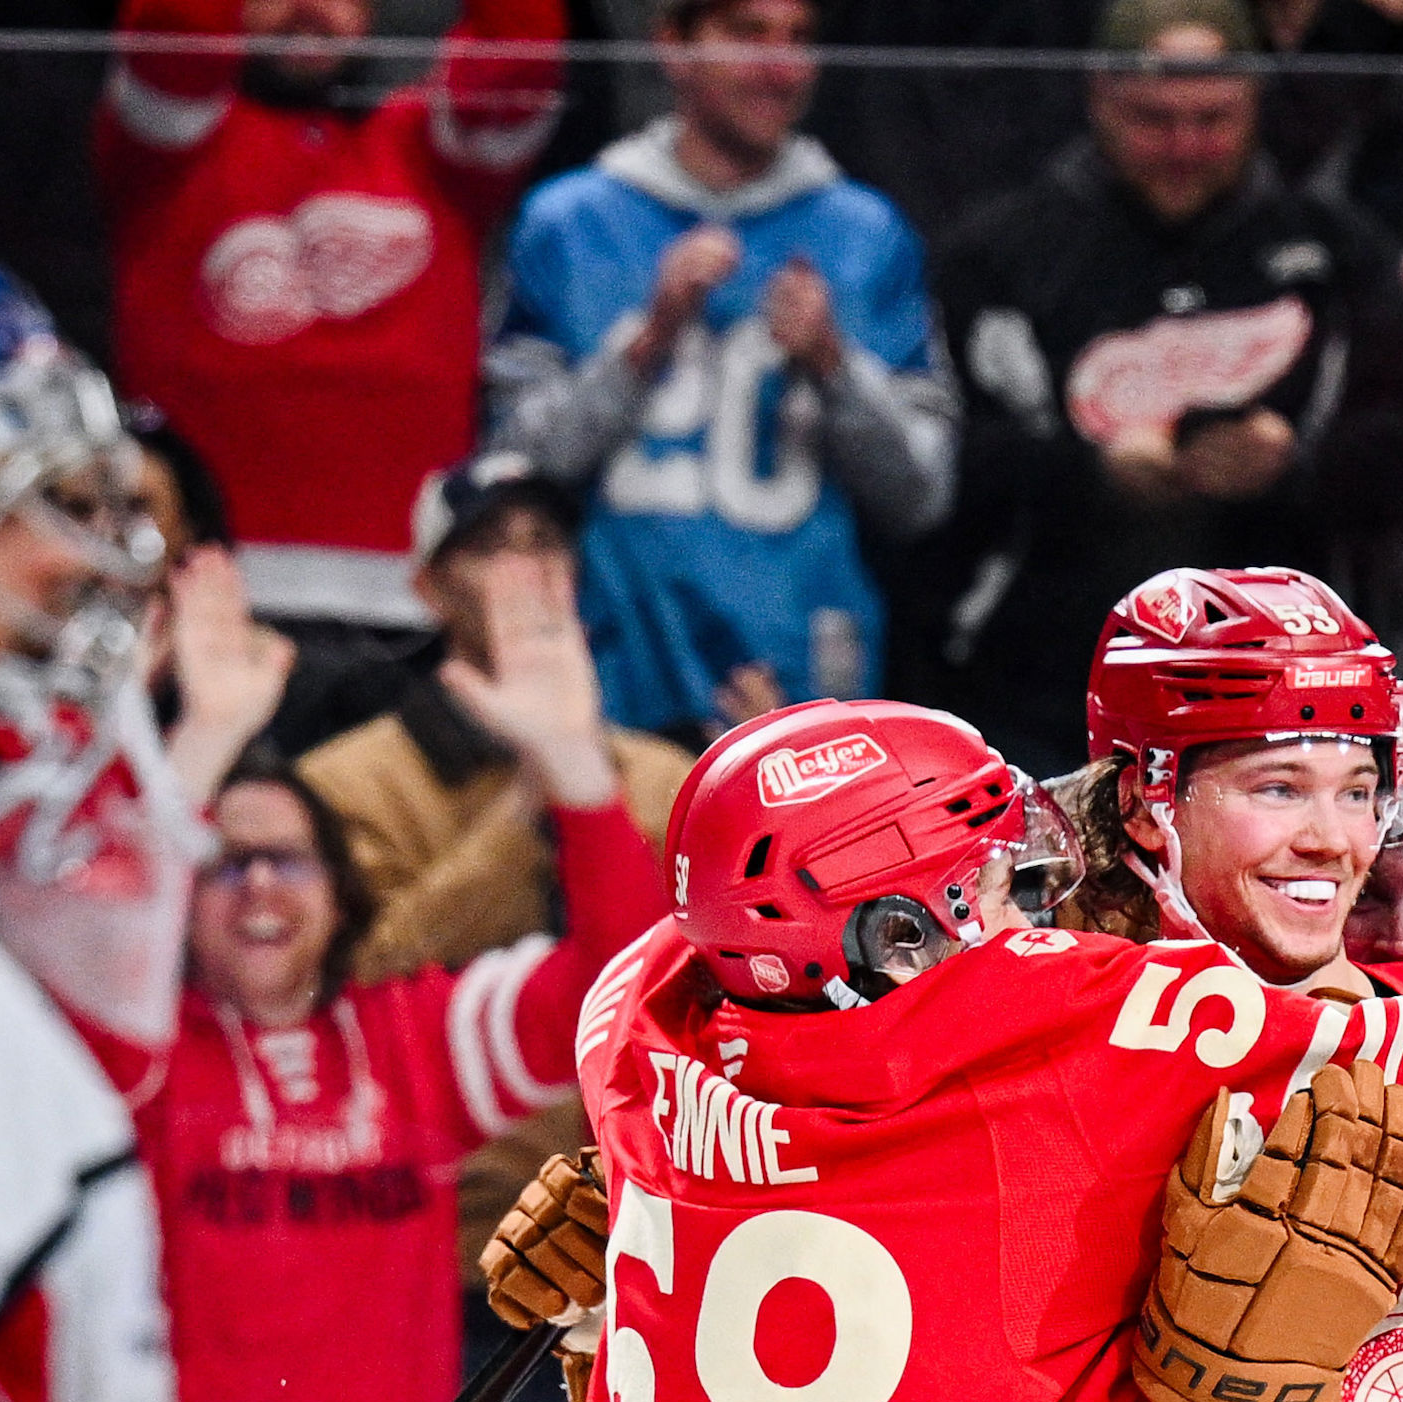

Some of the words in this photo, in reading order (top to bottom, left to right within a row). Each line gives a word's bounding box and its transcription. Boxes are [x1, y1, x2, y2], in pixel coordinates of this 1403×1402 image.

[1275, 605, 1340, 636] 53
[1294, 664, 1366, 688] bauer
[763, 740, 868, 796] Meijer
[1109, 960, 1266, 1069] 5
[649, 1051, 819, 1186] FINNIE
